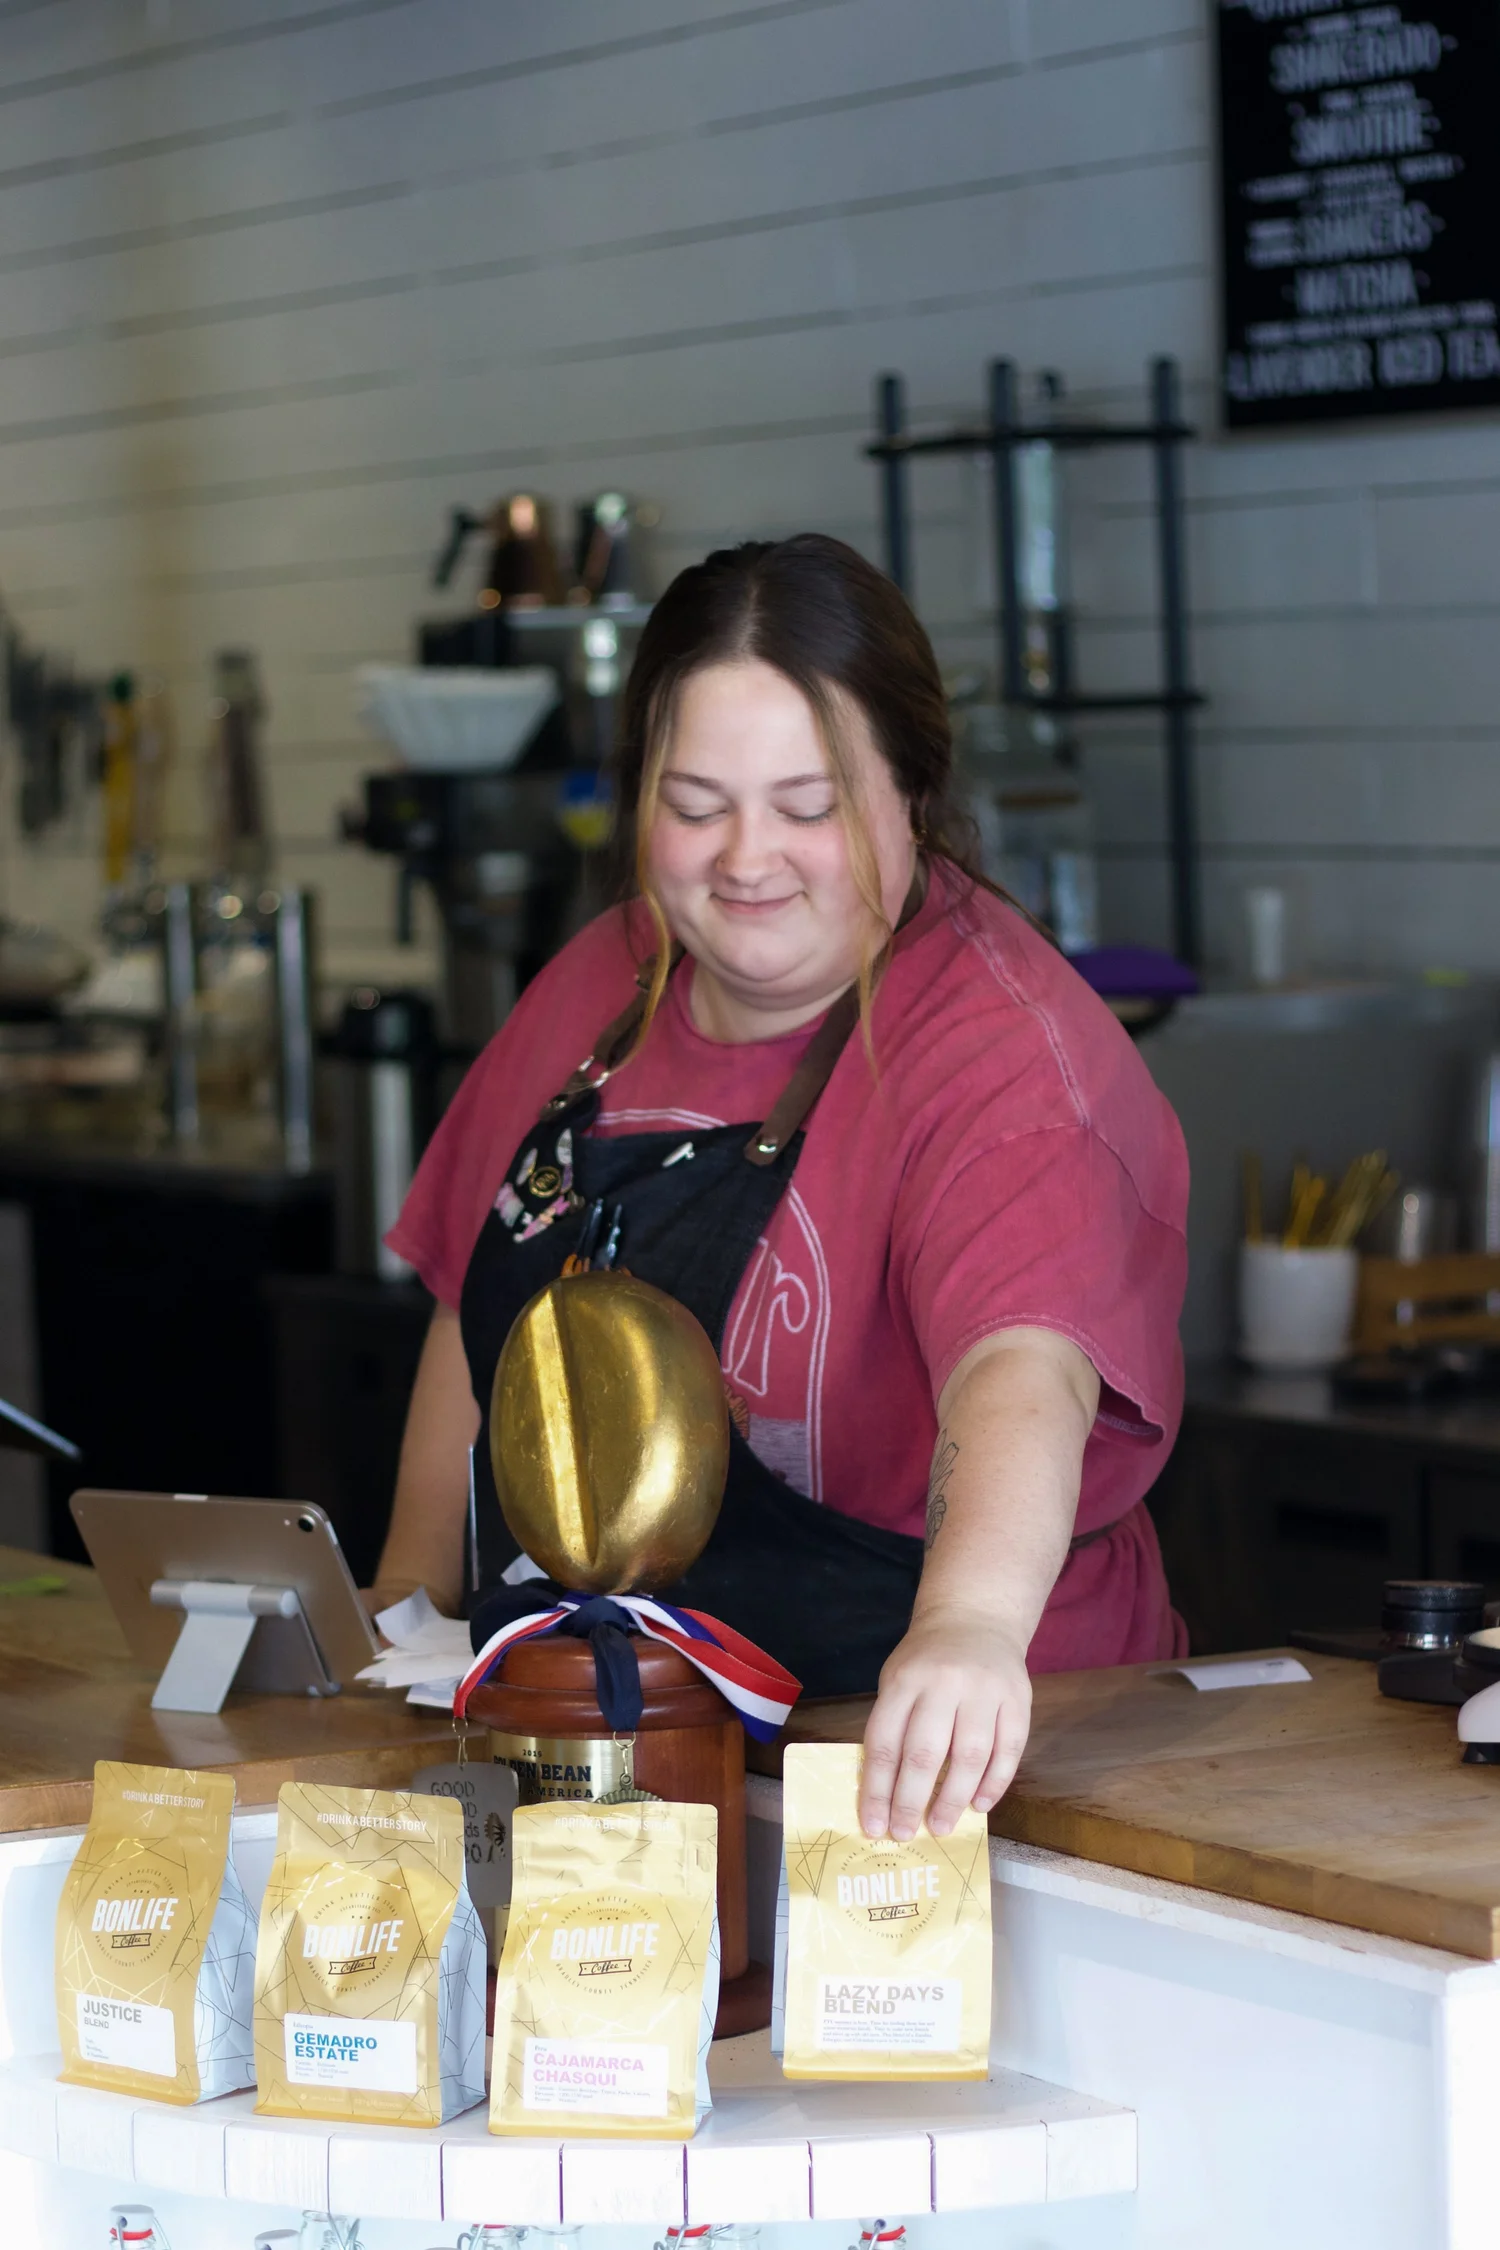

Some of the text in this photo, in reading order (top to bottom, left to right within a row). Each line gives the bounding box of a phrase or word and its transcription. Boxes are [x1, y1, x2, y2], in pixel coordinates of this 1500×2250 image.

[541, 1764, 591, 1782] BEAN
[431, 1780, 475, 1797] GOOD
[528, 1787, 594, 1798] AMERICA
[122, 1790, 205, 1809] #DRINKABETTERSTORY
[317, 1813, 427, 1831] #DRINKABETTERSTORY
[837, 1864, 940, 1906] BONLIFE
[91, 1898, 179, 1933] BONLIFE
[881, 1906, 906, 1919] Coffee
[120, 1935, 142, 1947] Coffee
[302, 1920, 404, 1958] BONLIFE
[550, 1923, 659, 1961] BONLIFE
[341, 1960, 366, 1973] Coffee
[591, 1960, 620, 1974] Coffee
[825, 1984, 944, 2001] LAZY DAYS
[83, 2000, 142, 2023] JUSTICE
[824, 1999, 896, 2014] BLEND
[84, 2017, 109, 2029] BLEND
[294, 2032, 377, 2050] GEMADRO
[295, 2045, 359, 2062] ESTATE
[533, 2053, 644, 2071] CAJAMARCA
[533, 2069, 617, 2086] CHASQUI
